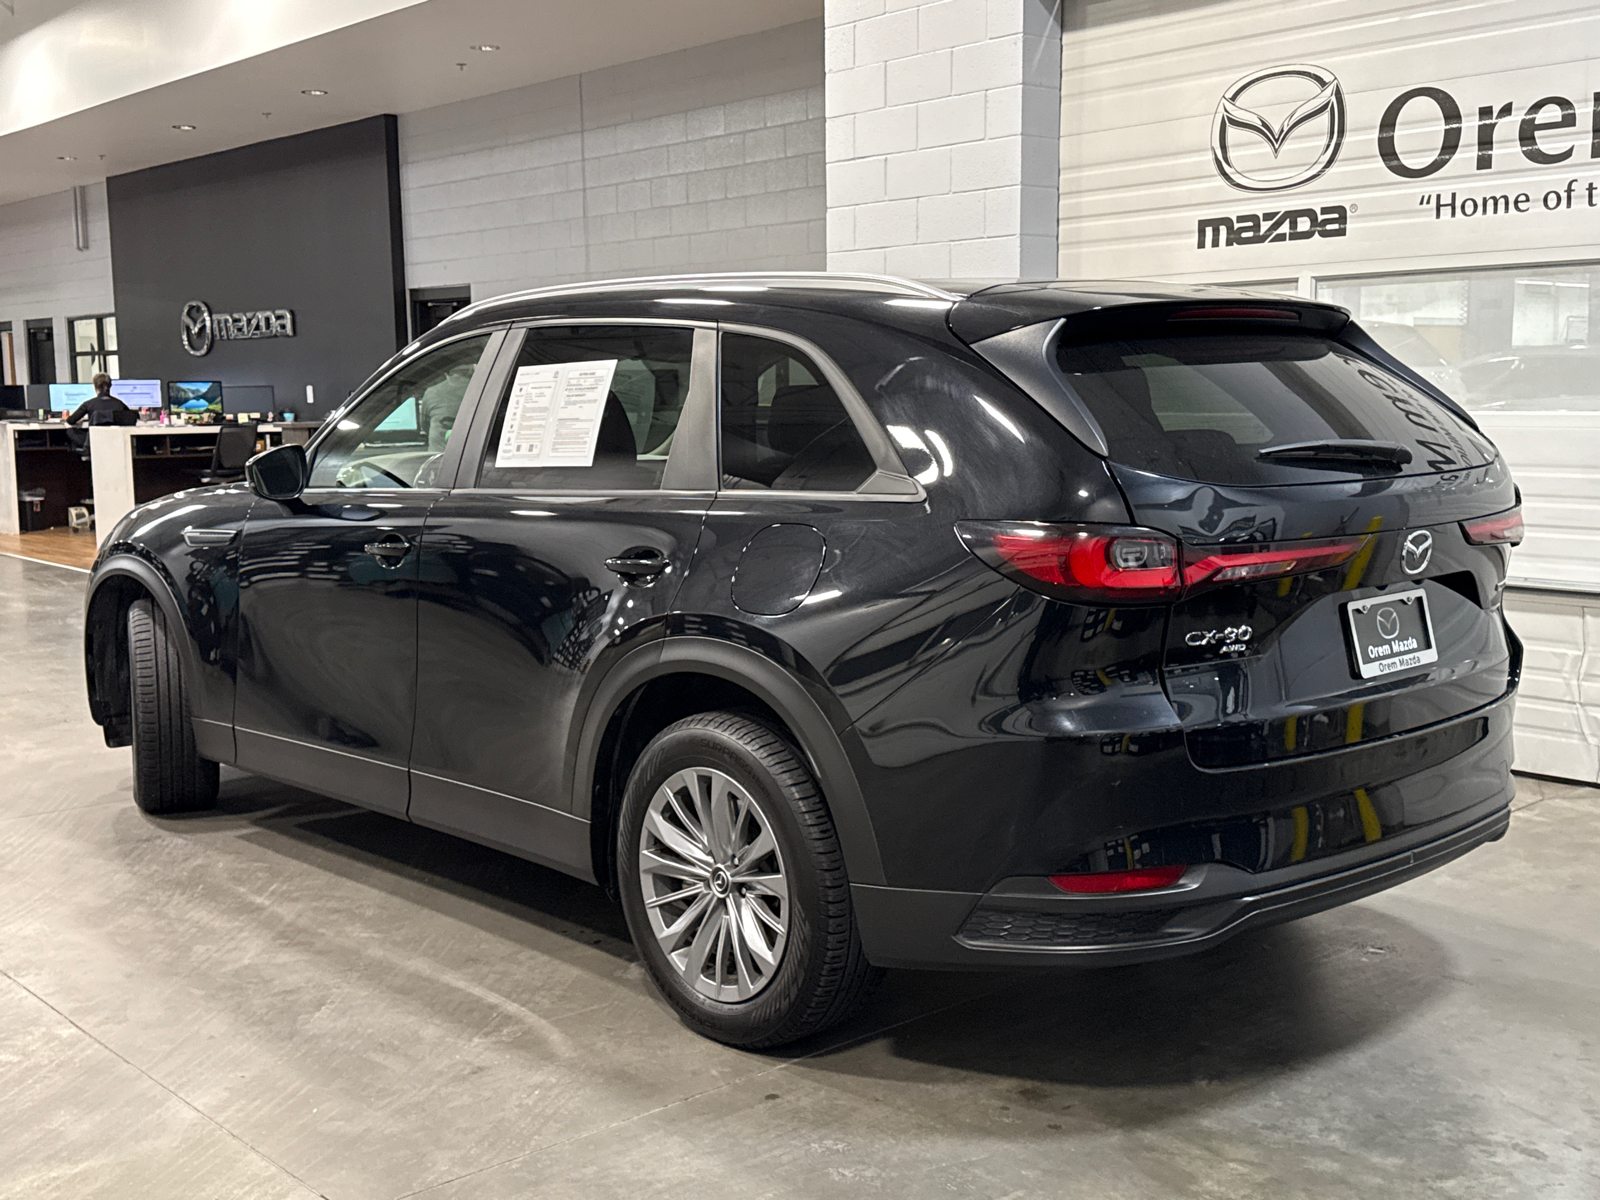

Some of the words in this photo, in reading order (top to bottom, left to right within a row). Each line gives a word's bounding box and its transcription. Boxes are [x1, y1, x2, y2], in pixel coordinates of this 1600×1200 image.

[1377, 86, 1600, 179] Ore
[1542, 178, 1578, 211] of
[1184, 624, 1253, 646] CX-90
[1219, 643, 1246, 654] AWD
[1368, 644, 1391, 659] Orem
[1391, 636, 1418, 654] Mazda
[1378, 661, 1398, 673] Orem
[1398, 654, 1421, 668] Mazda
[700, 738, 753, 775] SURPASS
